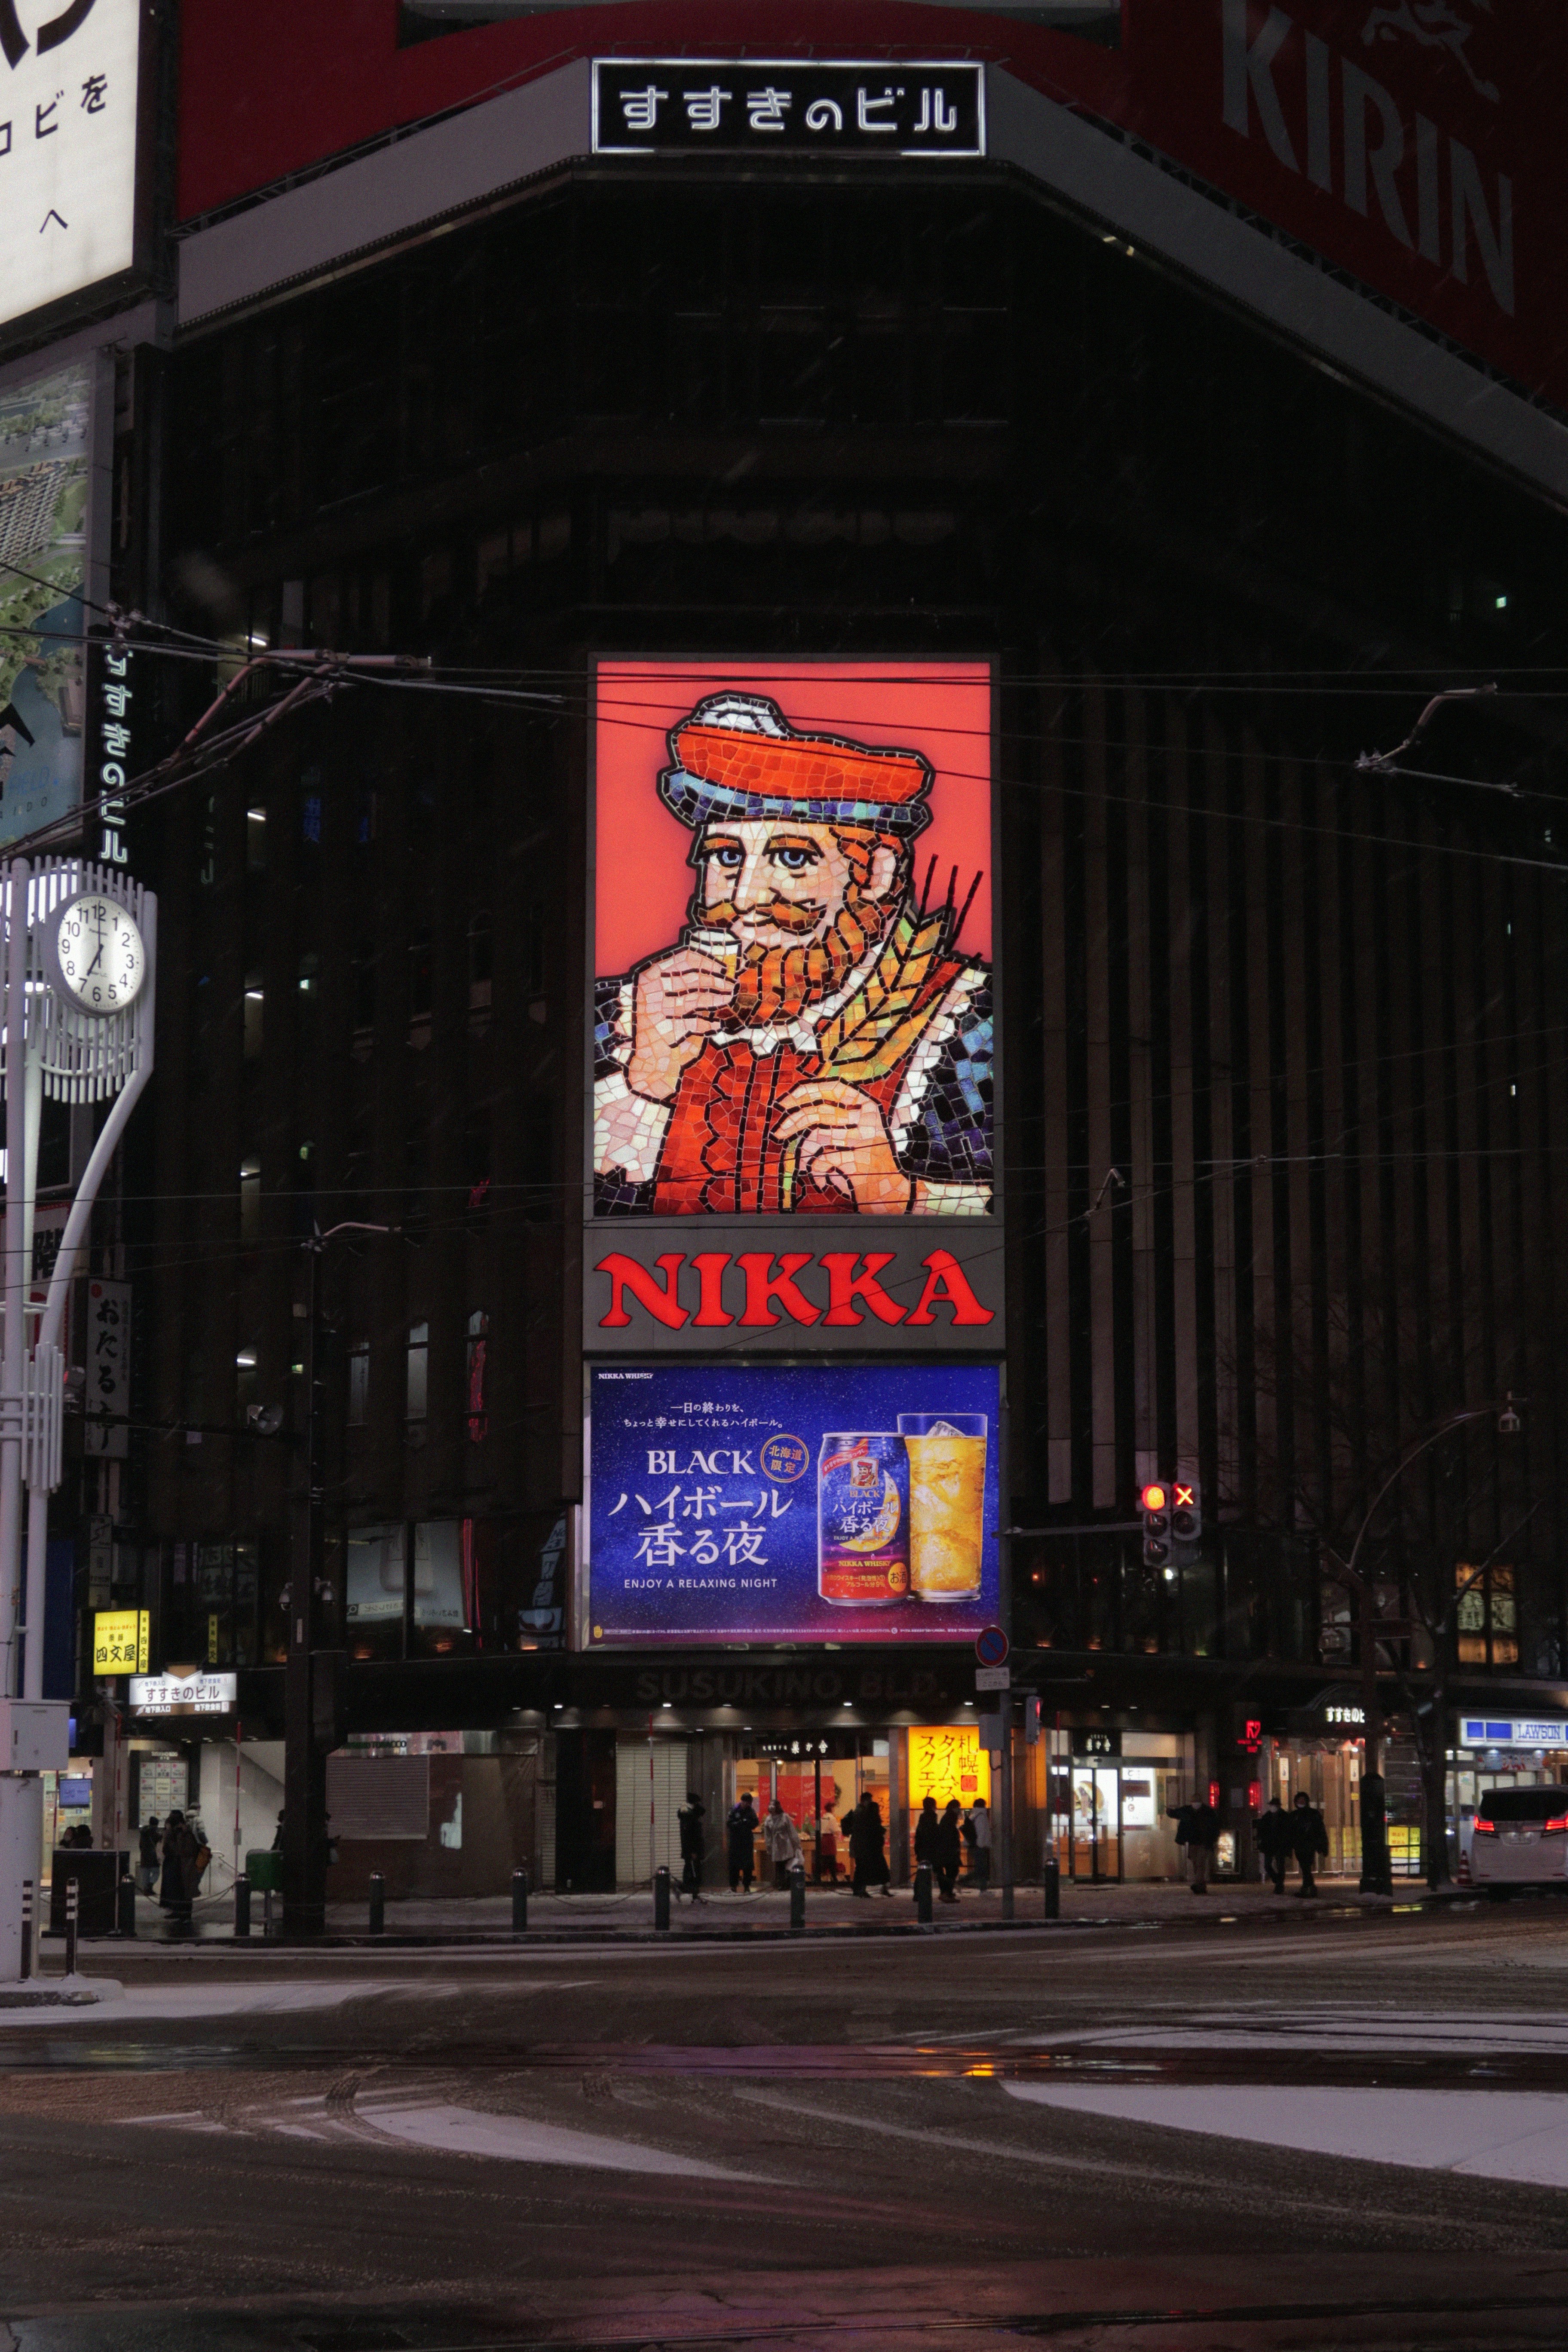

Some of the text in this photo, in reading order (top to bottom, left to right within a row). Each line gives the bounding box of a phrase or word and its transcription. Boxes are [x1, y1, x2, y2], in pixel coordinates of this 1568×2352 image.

[619, 85, 957, 132] すすきのビル
[1222, 0, 1515, 318] KIRIN
[77, 908, 89, 923] 11
[92, 906, 106, 921] 12
[65, 922, 80, 937] 10
[112, 917, 119, 931] 1
[62, 939, 70, 954] 9
[122, 933, 130, 947] 2
[66, 961, 75, 976] 8
[126, 954, 135, 969] 3
[79, 978, 87, 993] 7
[119, 973, 128, 987] 4
[92, 987, 101, 1002] 6
[108, 984, 117, 1000] 5
[594, 1249, 995, 1330] NIKKA
[671, 1402, 744, 1414] 一日の終わりを、
[624, 1416, 784, 1429] ちょっと幸せにしてくれるハイボール。
[768, 1445, 803, 1461] 北海道
[647, 1450, 756, 1475] BLACK
[771, 1459, 796, 1474] 限定
[849, 1490, 880, 1498] BLACK
[608, 1485, 793, 1520] ハイボール
[832, 1501, 899, 1515] ハイボール
[839, 1516, 890, 1534] 香る夜
[633, 1521, 769, 1567] 香る夜
[624, 1578, 778, 1589] ENJOY A RELAXING NIGHT
[890, 1571, 907, 1584] お酒
[96, 1643, 135, 1663] 四文屋
[637, 1671, 842, 1700] SUSUKINO
[146, 1685, 220, 1702] すすきのビル
[1518, 1723, 1561, 1740] LAWSON
[958, 1735, 979, 1773] 札幌
[918, 1735, 936, 1798] スクエア
[938, 1734, 959, 1800] タイムズ
